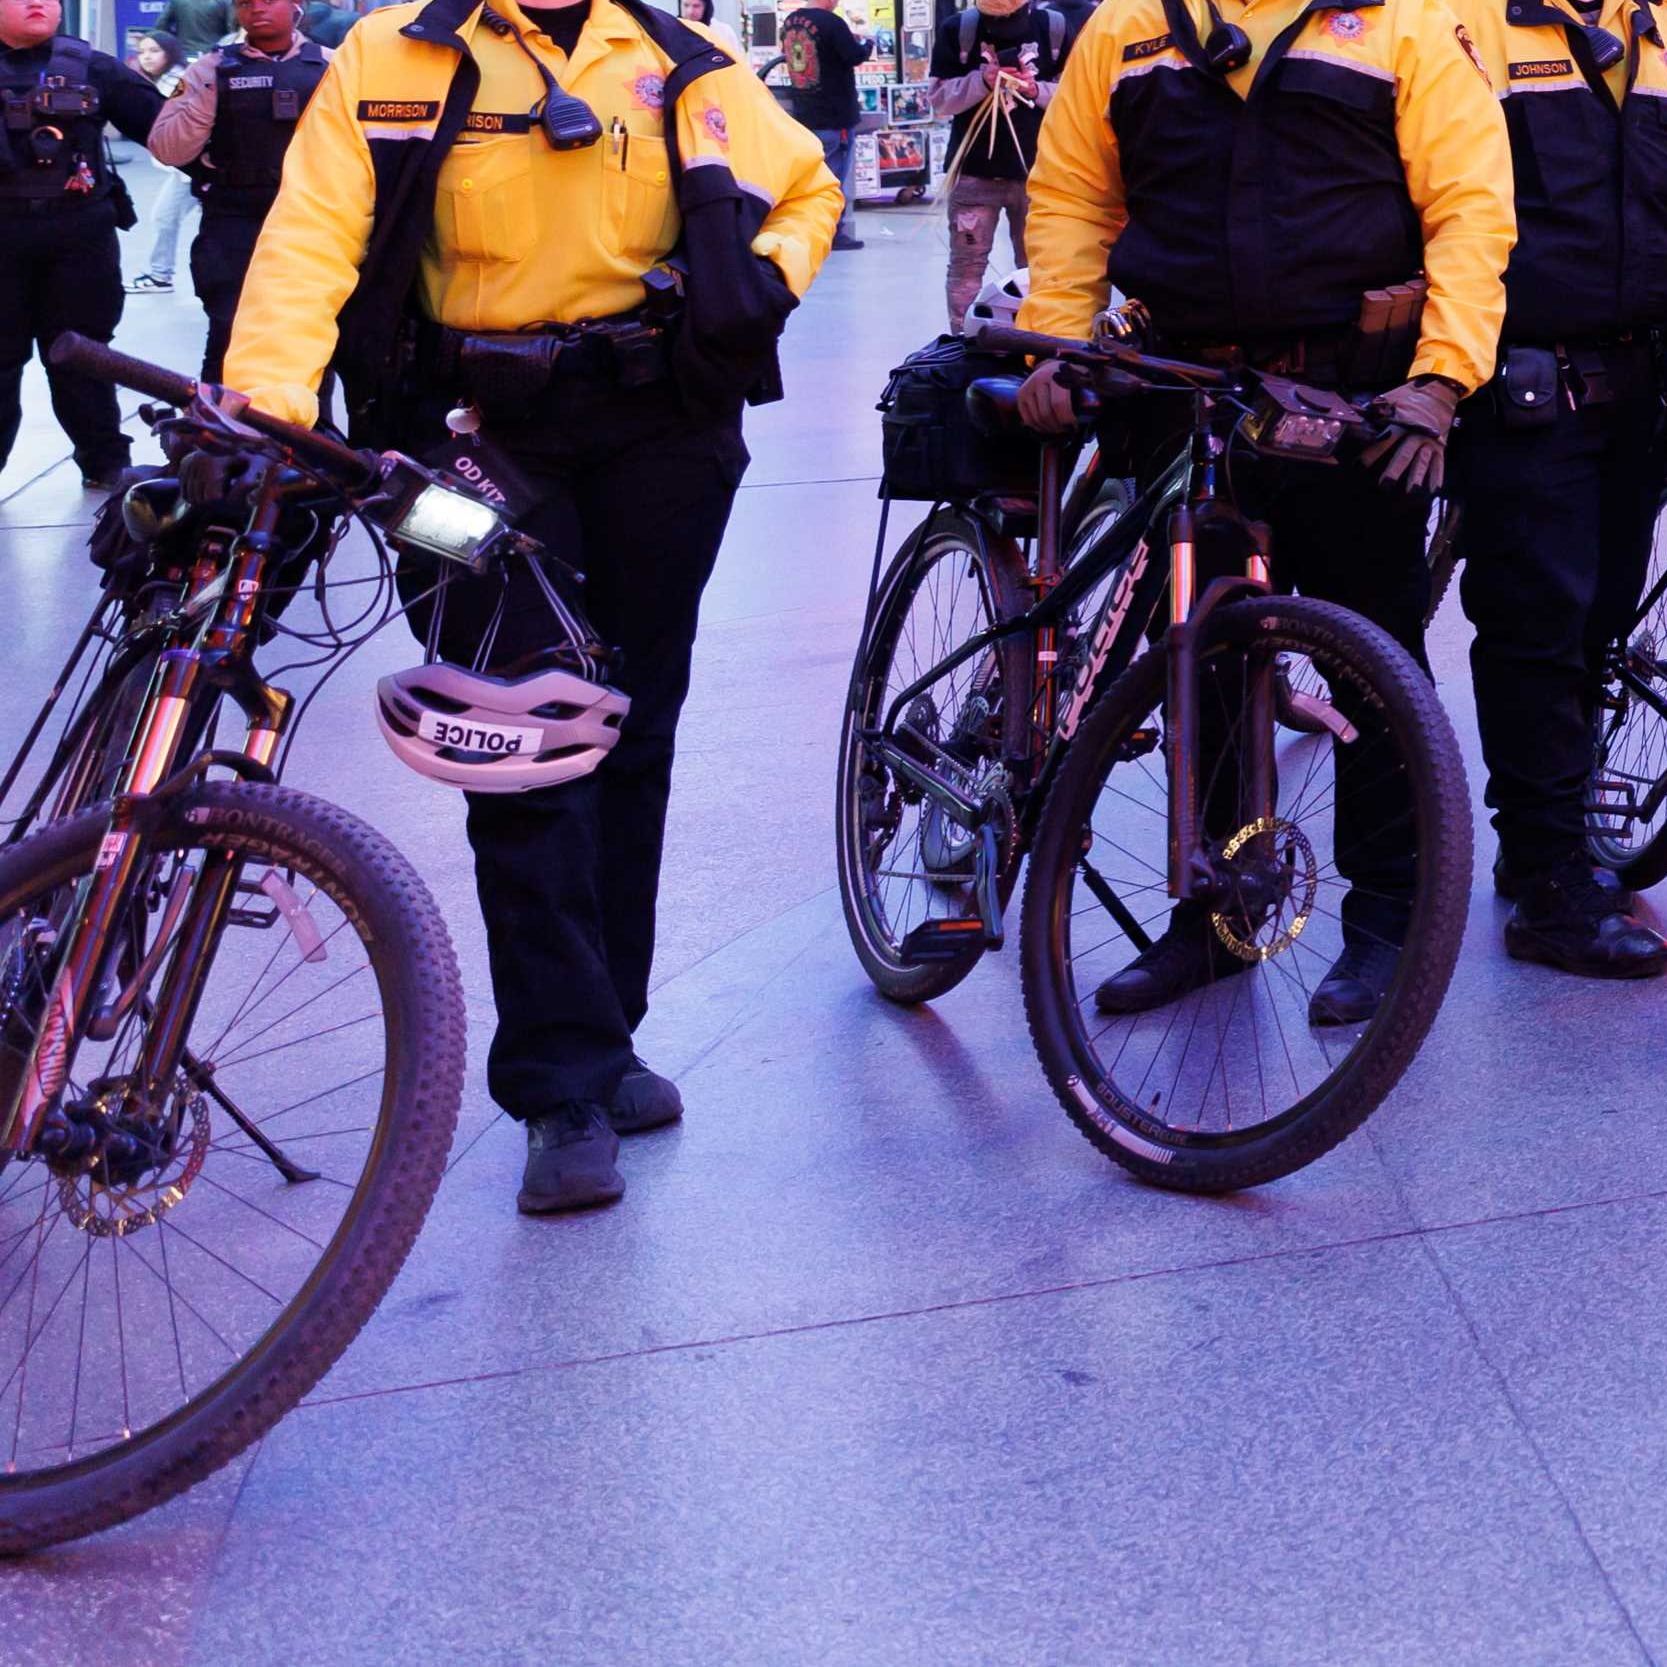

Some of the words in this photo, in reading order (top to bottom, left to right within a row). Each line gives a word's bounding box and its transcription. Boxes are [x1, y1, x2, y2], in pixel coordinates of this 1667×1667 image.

[1135, 36, 1166, 55] KYLE
[1515, 62, 1568, 76] JOHNSON
[229, 76, 273, 89] SECURITY
[367, 103, 428, 118] MORRISON
[455, 457, 482, 481] OD
[478, 478, 506, 502] KIT
[432, 720, 525, 755] POLICE
